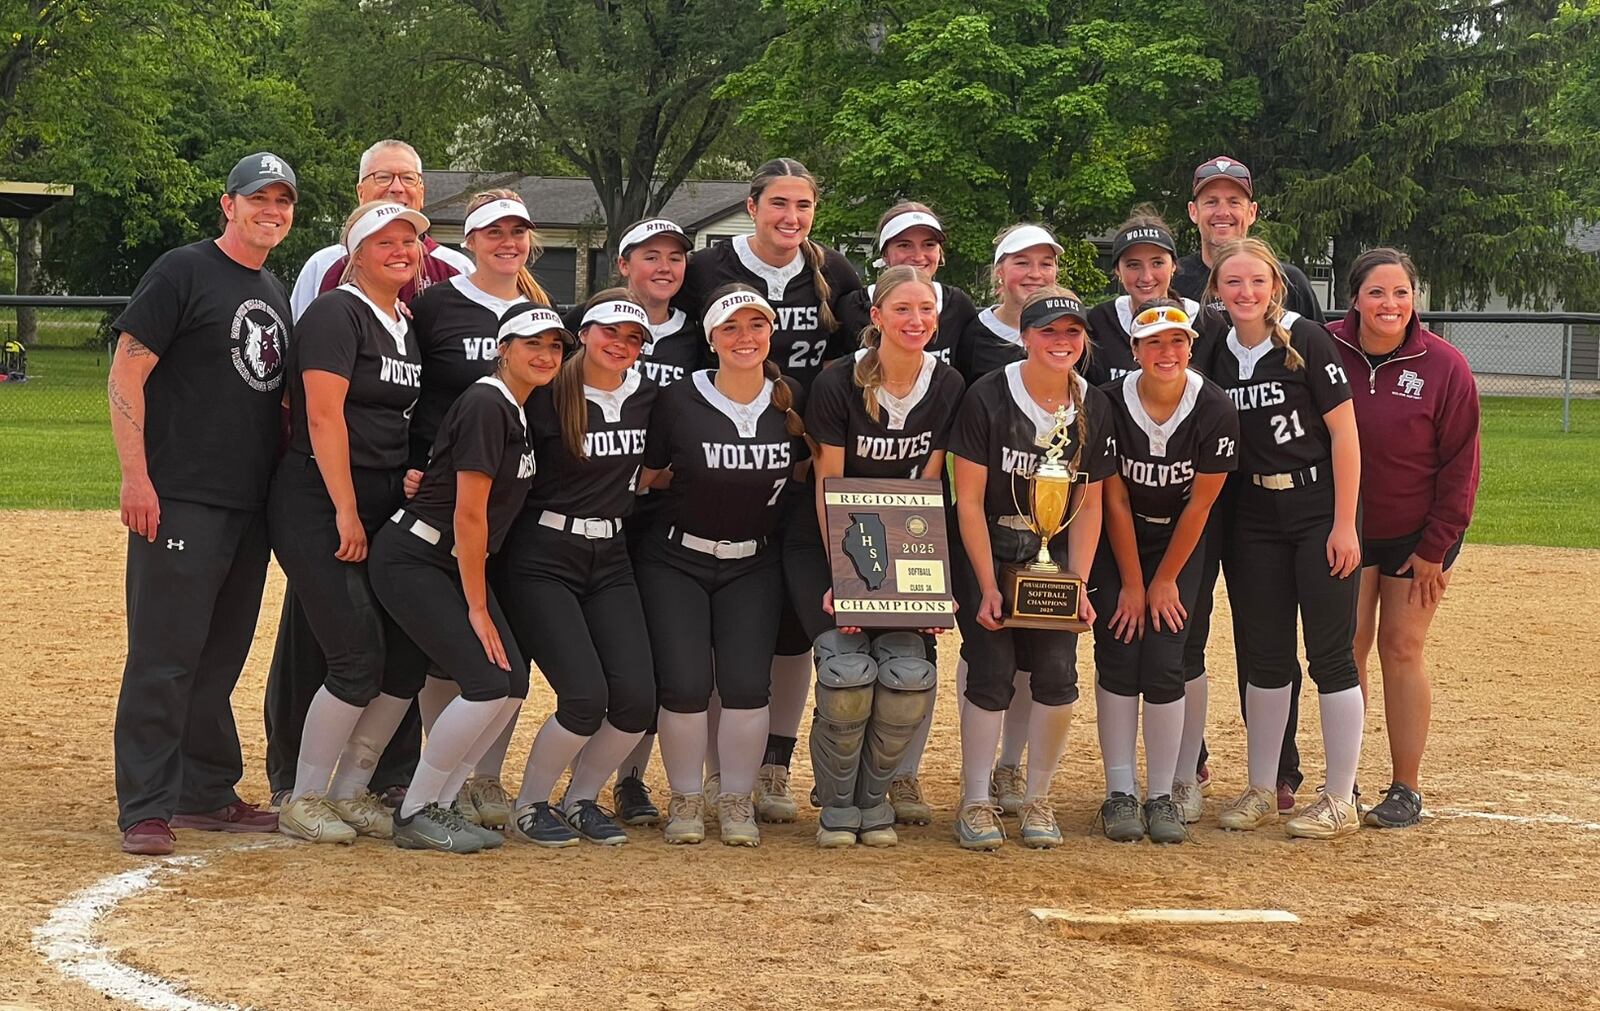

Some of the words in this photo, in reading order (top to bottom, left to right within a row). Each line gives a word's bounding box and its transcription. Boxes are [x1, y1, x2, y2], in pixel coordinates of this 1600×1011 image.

[1126, 229, 1160, 241] WOLVES
[613, 304, 645, 323] RIDGE
[1045, 299, 1080, 312] WOLVES
[774, 307, 818, 330] VES
[788, 340, 827, 368] 23
[1225, 381, 1286, 411] OLVES
[1270, 409, 1305, 445] 21
[702, 442, 791, 470] WOLVES
[856, 431, 932, 461] WOLVES
[1215, 436, 1235, 457] PR
[1121, 454, 1195, 487] WOLVES
[766, 477, 787, 507] 7
[840, 494, 930, 506] REGIONAL
[902, 543, 935, 554] 2025
[908, 567, 932, 577] SOFTBALL
[910, 584, 925, 592] CLASS
[1028, 591, 1067, 599] SOFTBALL
[840, 600, 946, 612] CHAMPIONS
